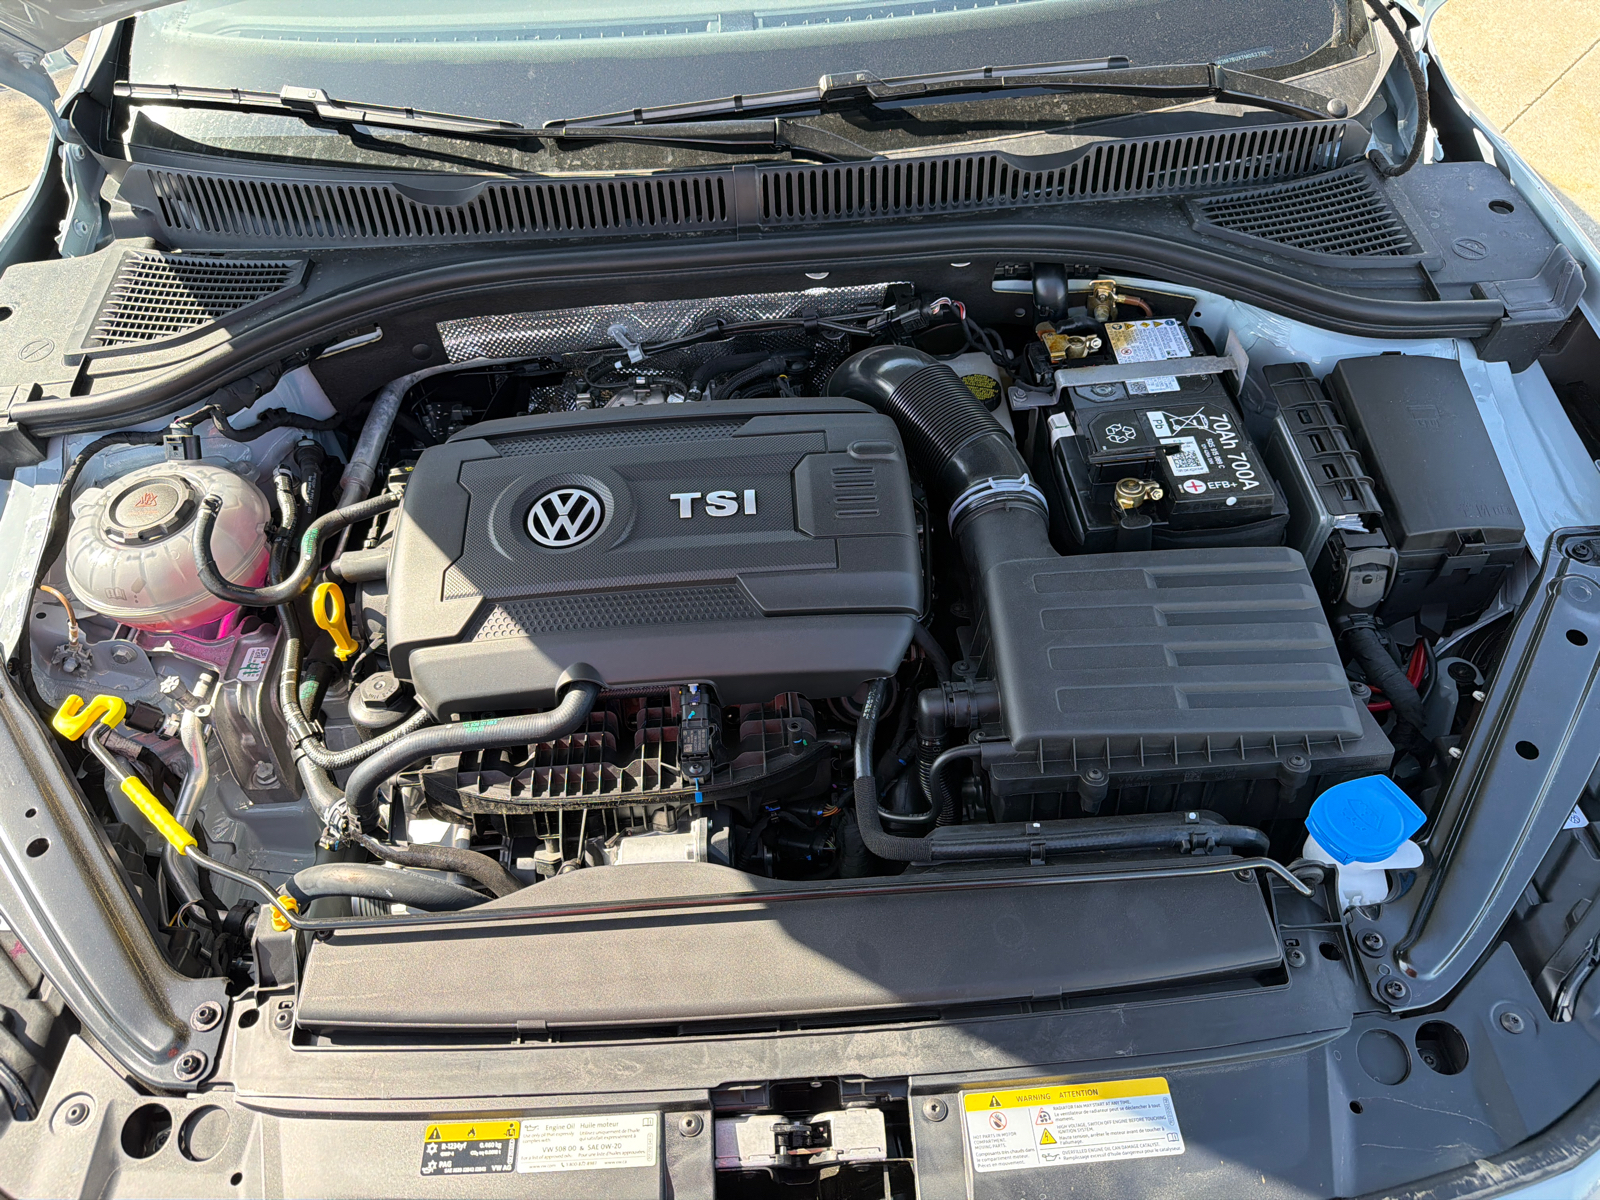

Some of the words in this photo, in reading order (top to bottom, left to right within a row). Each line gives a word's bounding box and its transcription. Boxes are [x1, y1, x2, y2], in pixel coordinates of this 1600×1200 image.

[1152, 419, 1163, 430] Pb
[1209, 413, 1239, 449] 70Ah
[1227, 452, 1260, 490] 700A
[1207, 480, 1238, 490] EFB+
[669, 489, 758, 518] TSI
[1016, 1093, 1051, 1102] WARNING
[1059, 1088, 1098, 1099] ATTENTION
